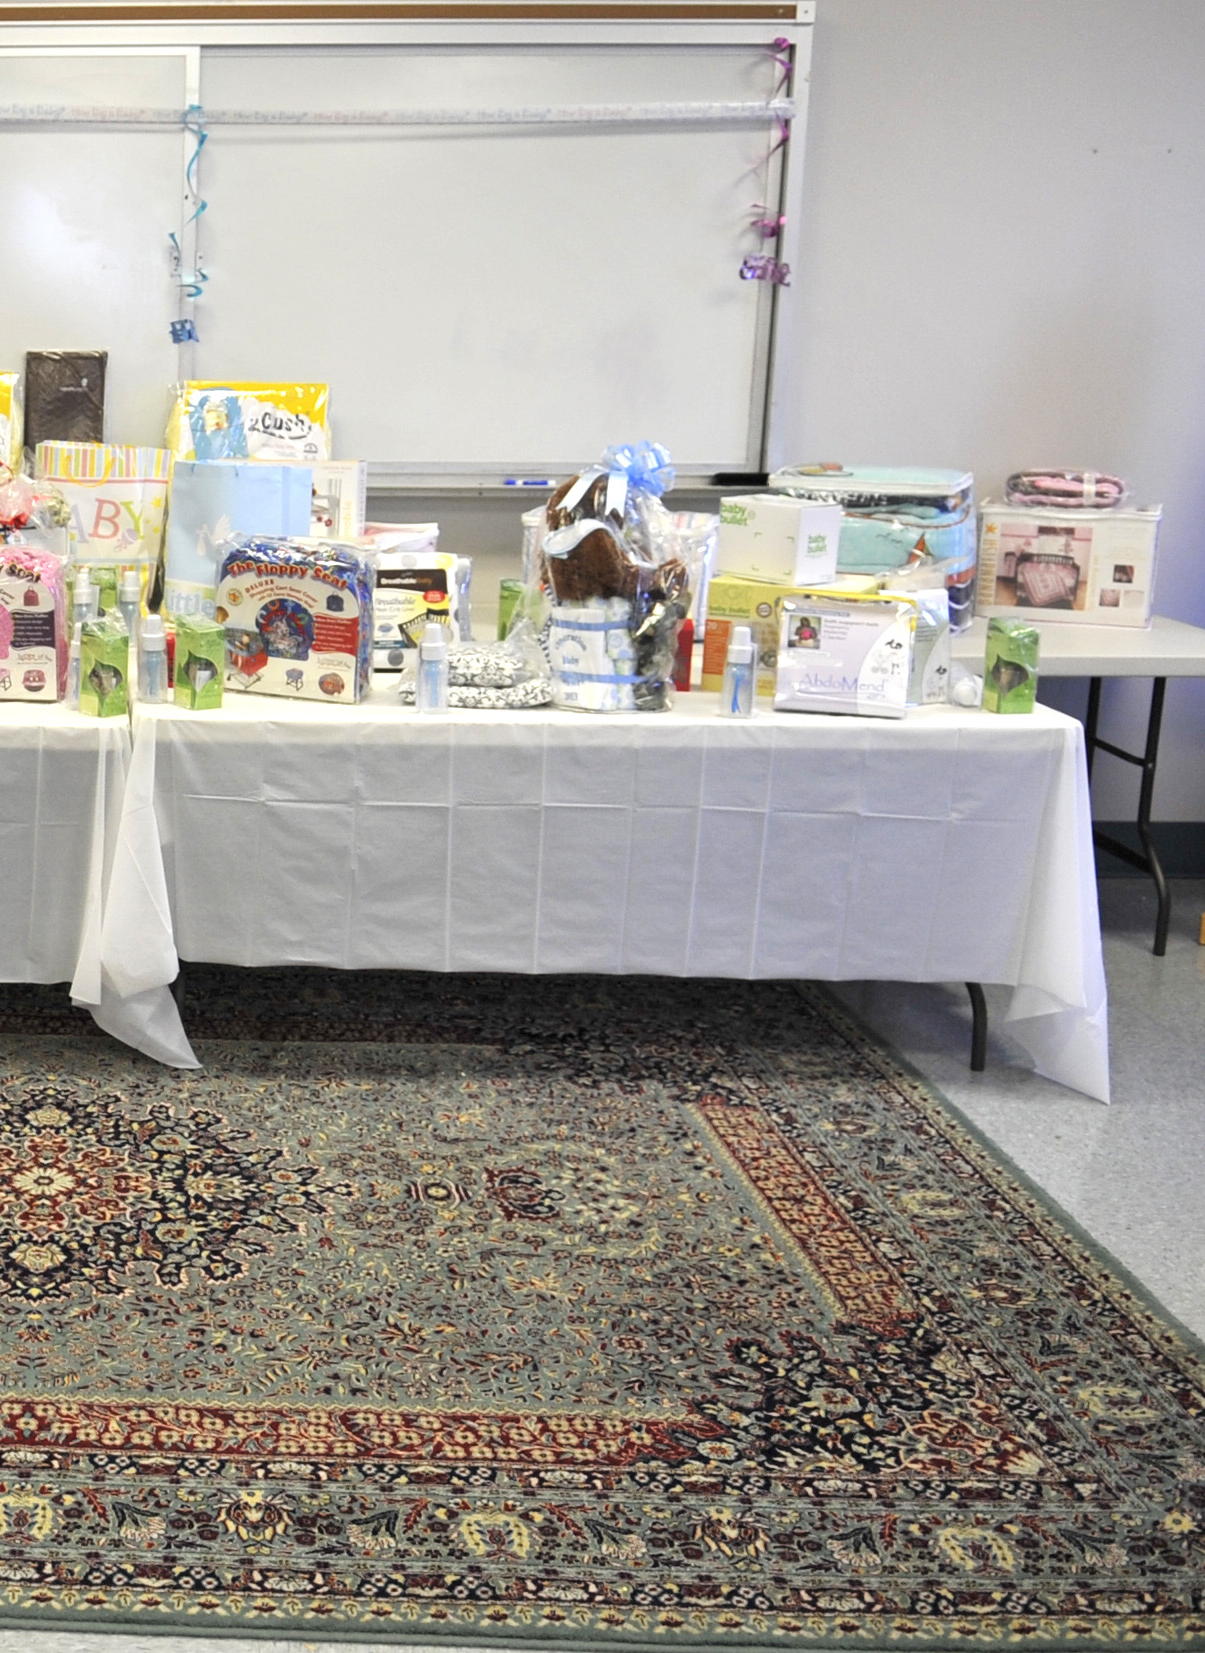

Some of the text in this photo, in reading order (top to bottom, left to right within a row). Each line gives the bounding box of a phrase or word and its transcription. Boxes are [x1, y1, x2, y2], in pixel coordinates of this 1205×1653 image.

[68, 498, 145, 544] ABY
[721, 503, 747, 516] baby
[228, 560, 348, 590] The Floppy Seat
[167, 589, 216, 617] ittle
[798, 674, 885, 692] AbdoMend
